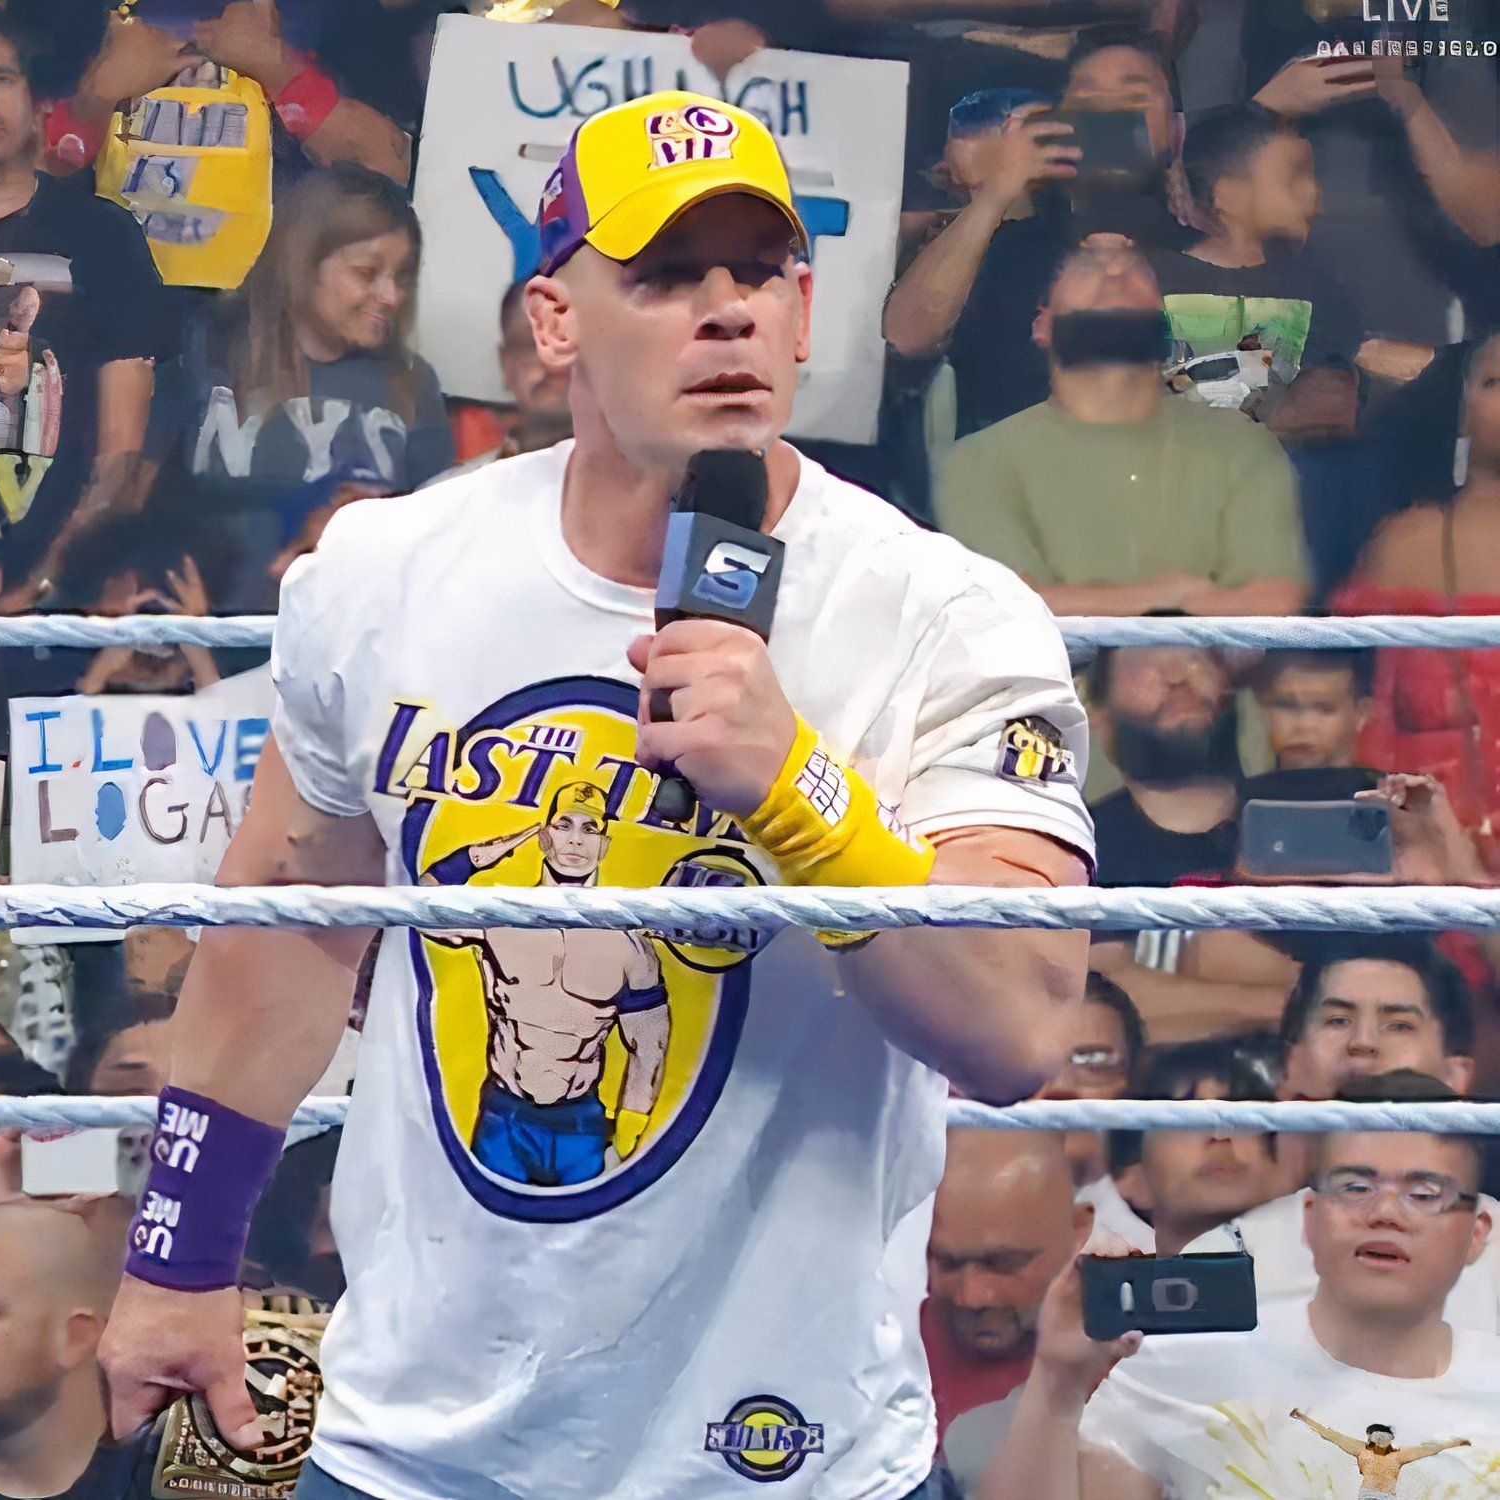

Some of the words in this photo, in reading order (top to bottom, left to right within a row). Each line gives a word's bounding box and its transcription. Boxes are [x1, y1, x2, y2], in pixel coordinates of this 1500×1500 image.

[91, 708, 270, 783] LOVE
[373, 702, 577, 809] LAST
[38, 777, 254, 846] LOGA
[160, 1102, 210, 1143] ME
